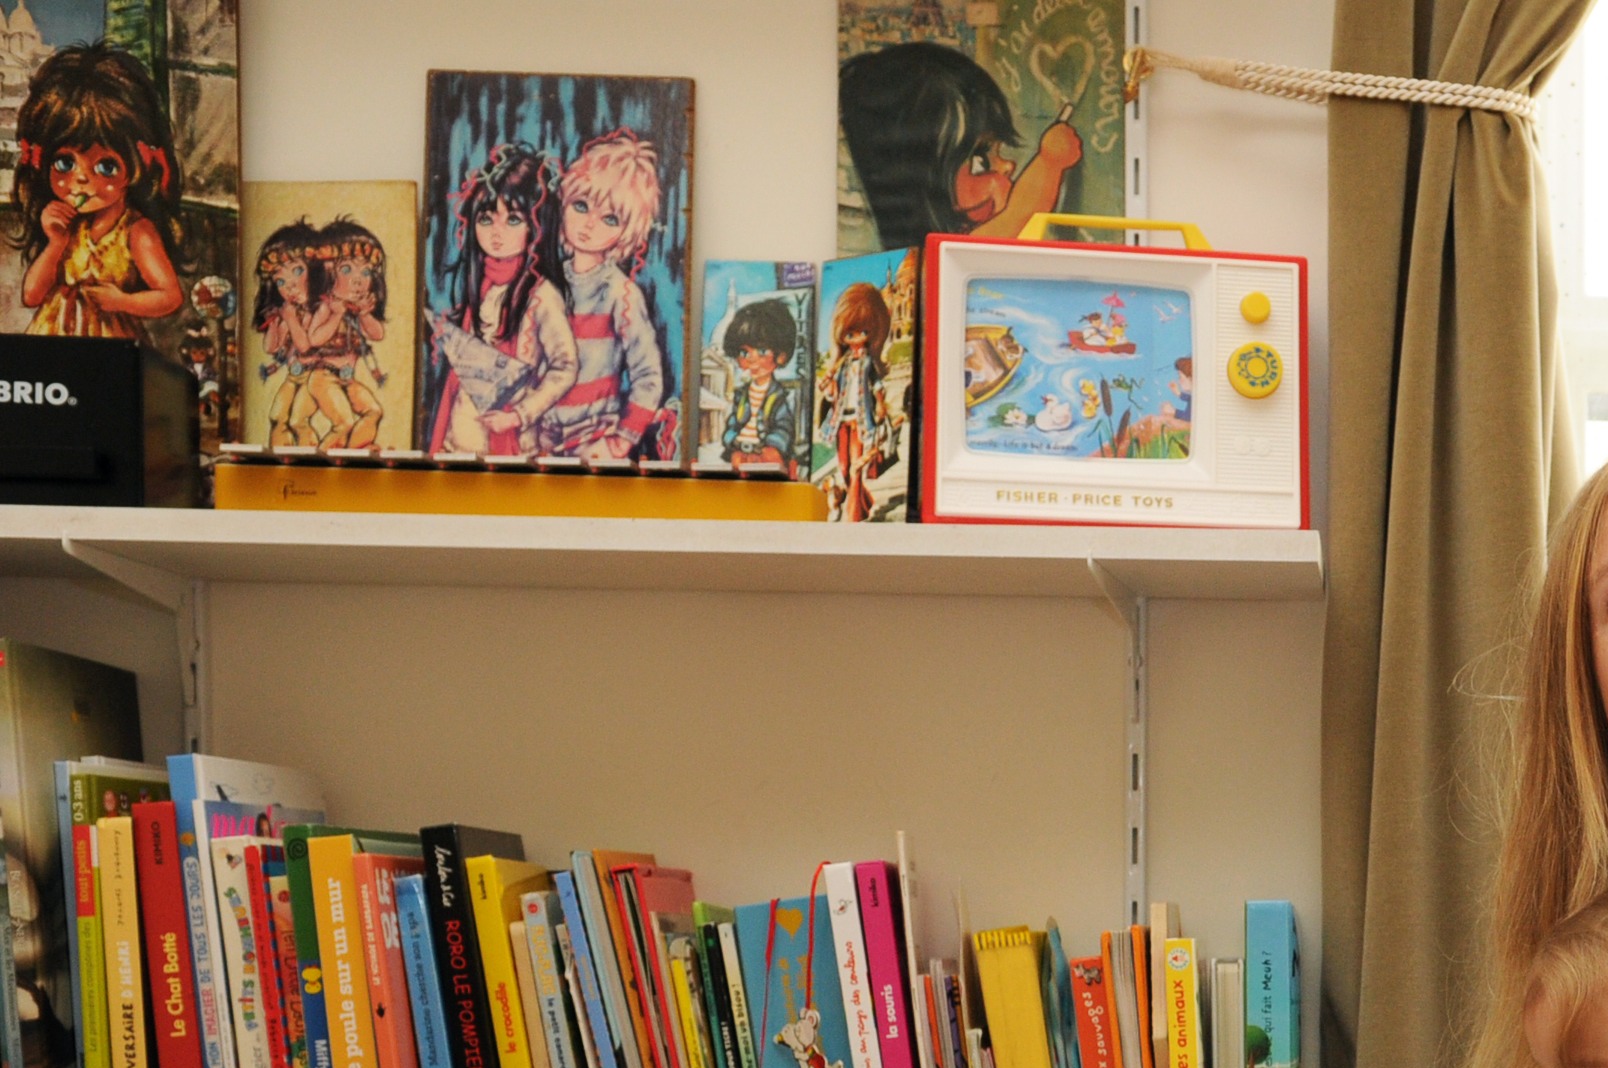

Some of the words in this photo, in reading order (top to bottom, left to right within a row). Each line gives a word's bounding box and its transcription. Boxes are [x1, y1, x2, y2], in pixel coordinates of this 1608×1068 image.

[996, 490, 1059, 503] FISHER
[1072, 493, 1123, 507] PRICE
[1132, 495, 1173, 509] TOYS
[71, 780, 83, 800] ans
[149, 821, 163, 865] KIMIKO
[184, 861, 202, 899] JOURS
[190, 904, 204, 927] LES
[327, 878, 344, 922] mur
[159, 932, 181, 974] Botté
[193, 934, 209, 962] TOUS
[332, 927, 347, 958] un
[444, 919, 465, 970] RORO
[197, 967, 211, 983] DE
[337, 962, 352, 995] sur
[416, 962, 430, 1006] cherche
[452, 974, 469, 996] LE
[1261, 959, 1273, 991] Meuh
[164, 978, 185, 1017] Chat
[200, 988, 217, 1036] IMAGIER
[495, 981, 515, 1038] crocodile
[851, 989, 862, 1006] des
[881, 984, 896, 1023] souris
[1262, 995, 1273, 1014] fait
[168, 1021, 187, 1037] Le
[546, 1009, 561, 1035] petit
[854, 1009, 869, 1037] pays
[1081, 991, 1108, 1056] sauvages
[1172, 979, 1187, 1048] animaux
[1263, 1017, 1275, 1033] qui
[340, 1001, 363, 1058] poule
[883, 1024, 899, 1039] la
[207, 1041, 223, 1066] MON
[504, 1042, 517, 1054] le
